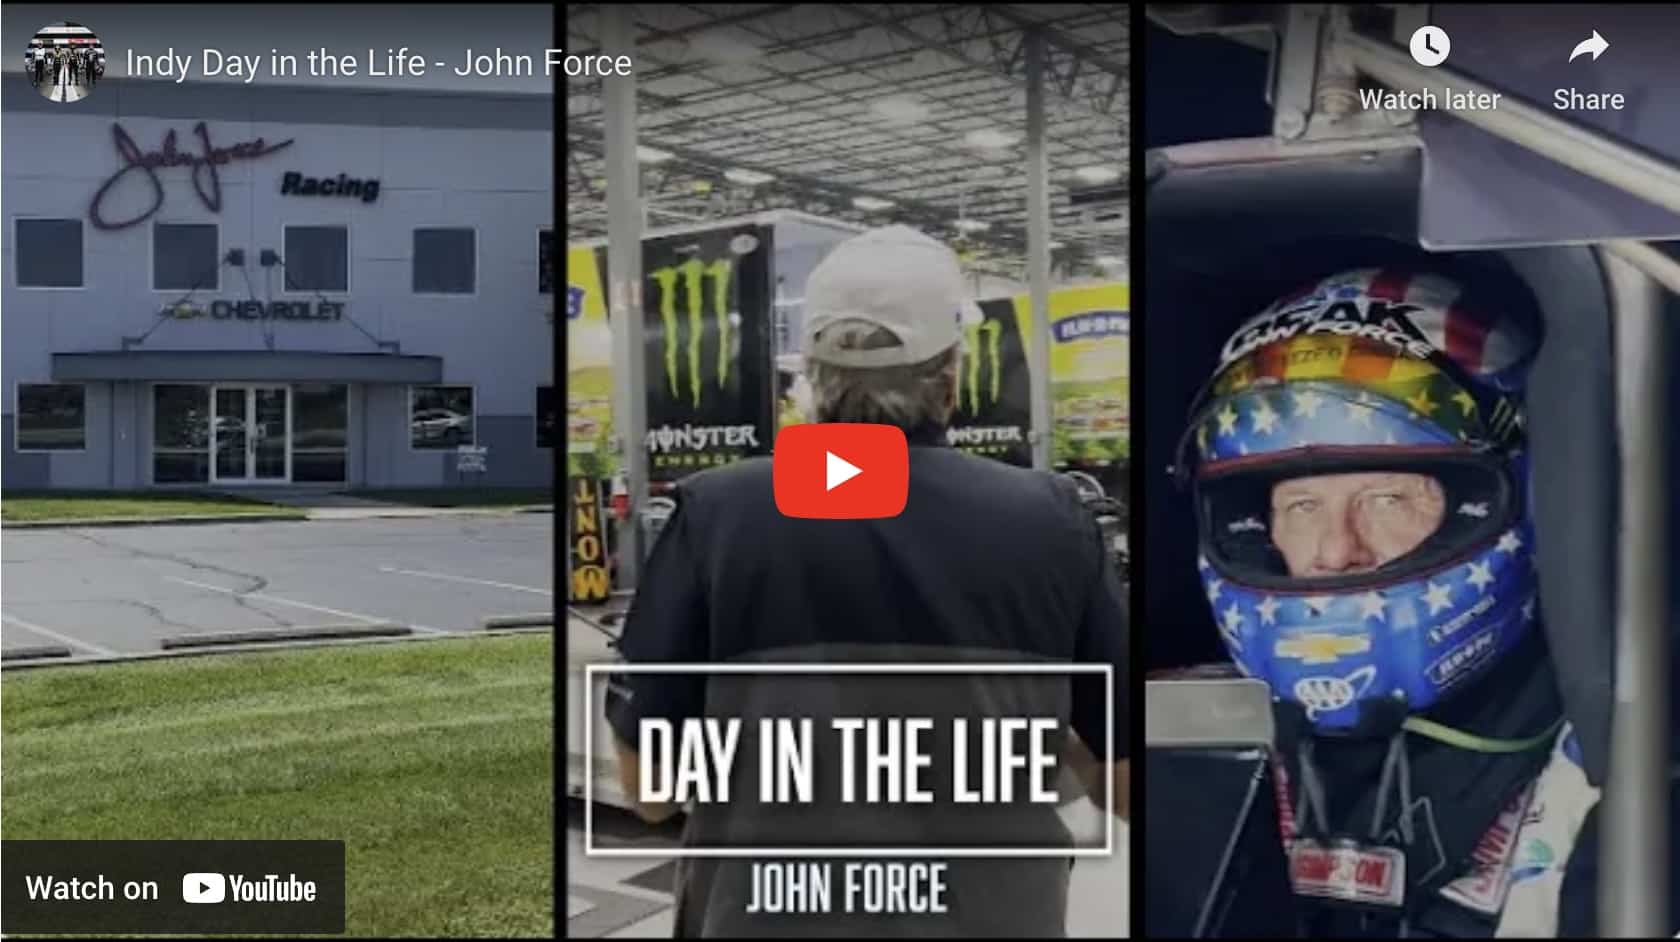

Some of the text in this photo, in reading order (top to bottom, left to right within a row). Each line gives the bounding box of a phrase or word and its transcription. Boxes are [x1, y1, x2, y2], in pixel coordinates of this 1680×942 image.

[280, 171, 381, 203] Racing
[211, 300, 345, 321] CHEVROLET
[1304, 320, 1434, 360] FORCE
